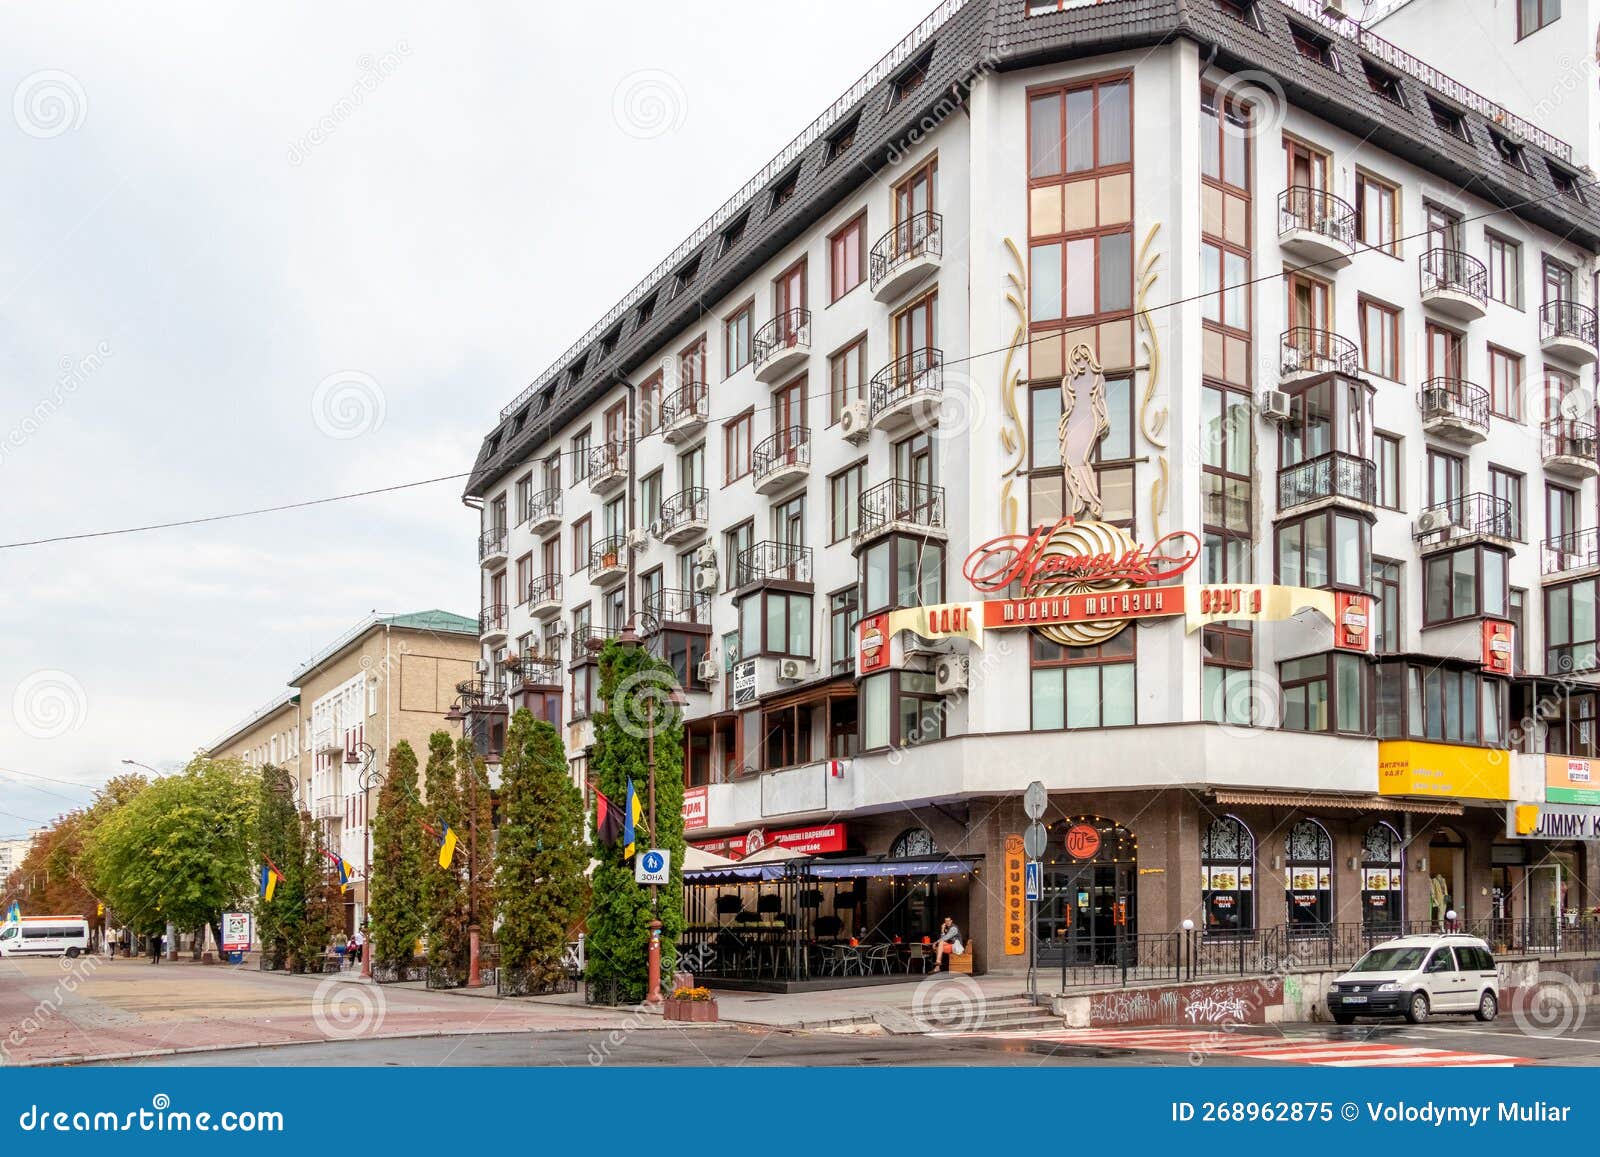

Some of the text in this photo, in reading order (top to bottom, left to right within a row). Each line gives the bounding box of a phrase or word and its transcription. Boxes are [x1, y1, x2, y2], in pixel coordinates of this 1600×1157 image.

[1004, 592, 1162, 621] МОДНИЙ МАГАЗИН
[929, 608, 972, 633] ОДЯГ
[1536, 813, 1587, 837] JIMMY
[1010, 859, 1021, 947] BURGERS
